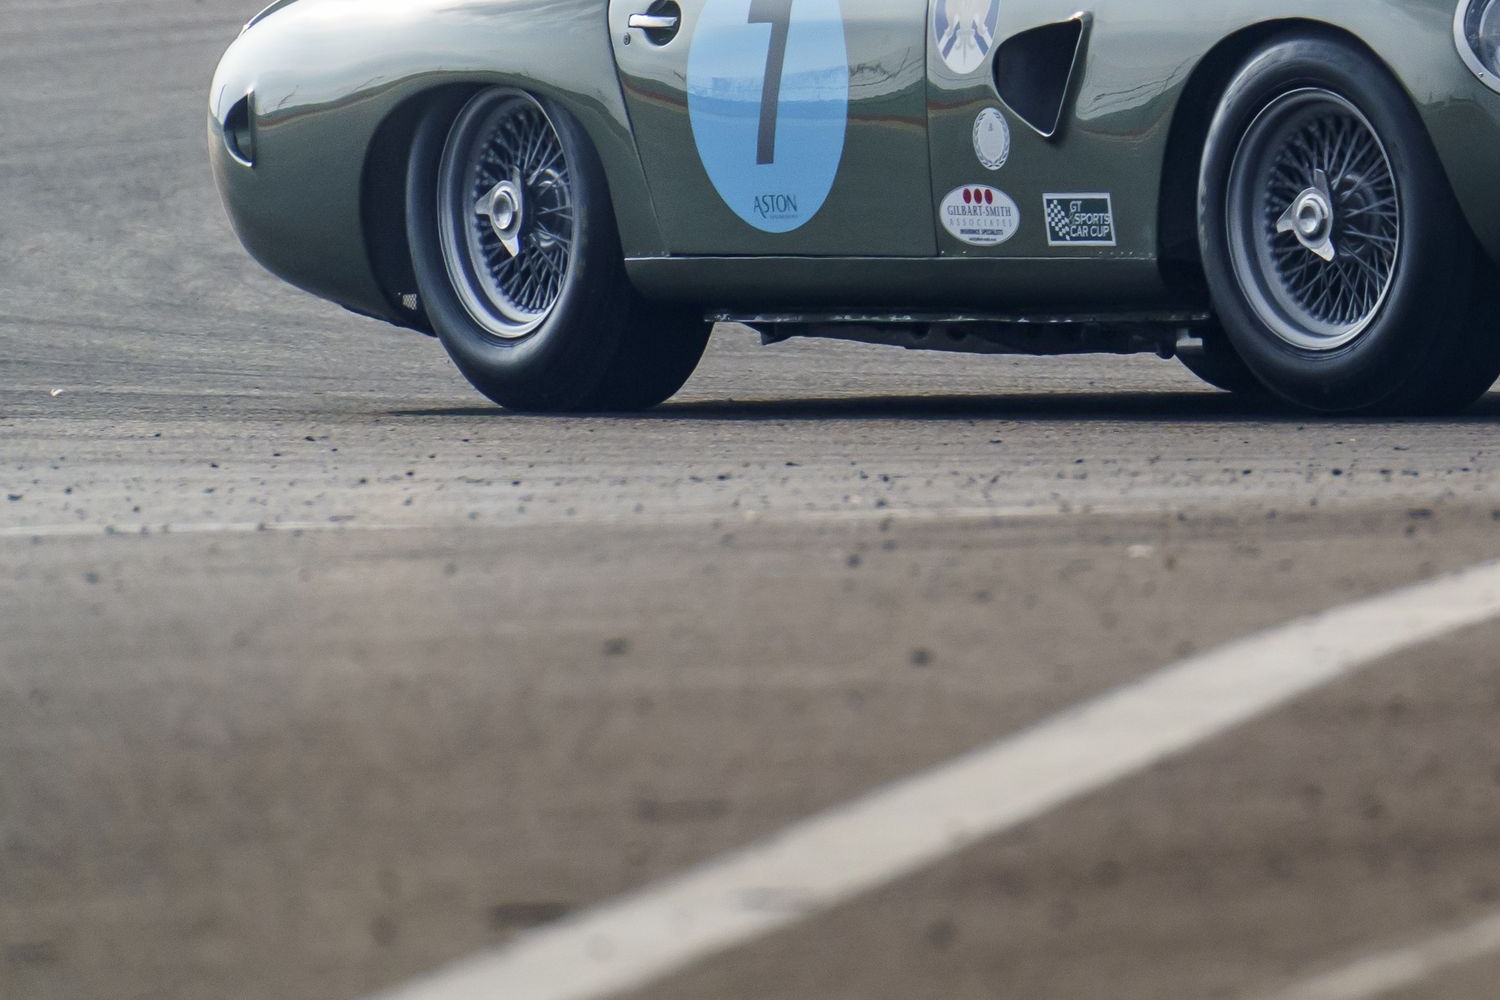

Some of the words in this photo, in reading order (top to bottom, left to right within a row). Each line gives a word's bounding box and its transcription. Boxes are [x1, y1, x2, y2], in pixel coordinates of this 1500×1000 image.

[753, 194, 798, 219] ASTON
[946, 205, 1012, 217] GILBART-SMITH
[1069, 200, 1082, 212] GT
[949, 217, 1013, 228] ASSOCIATES
[1074, 213, 1111, 225] SPORTS
[1070, 225, 1089, 237] CAR
[1090, 225, 1110, 237] CUP
